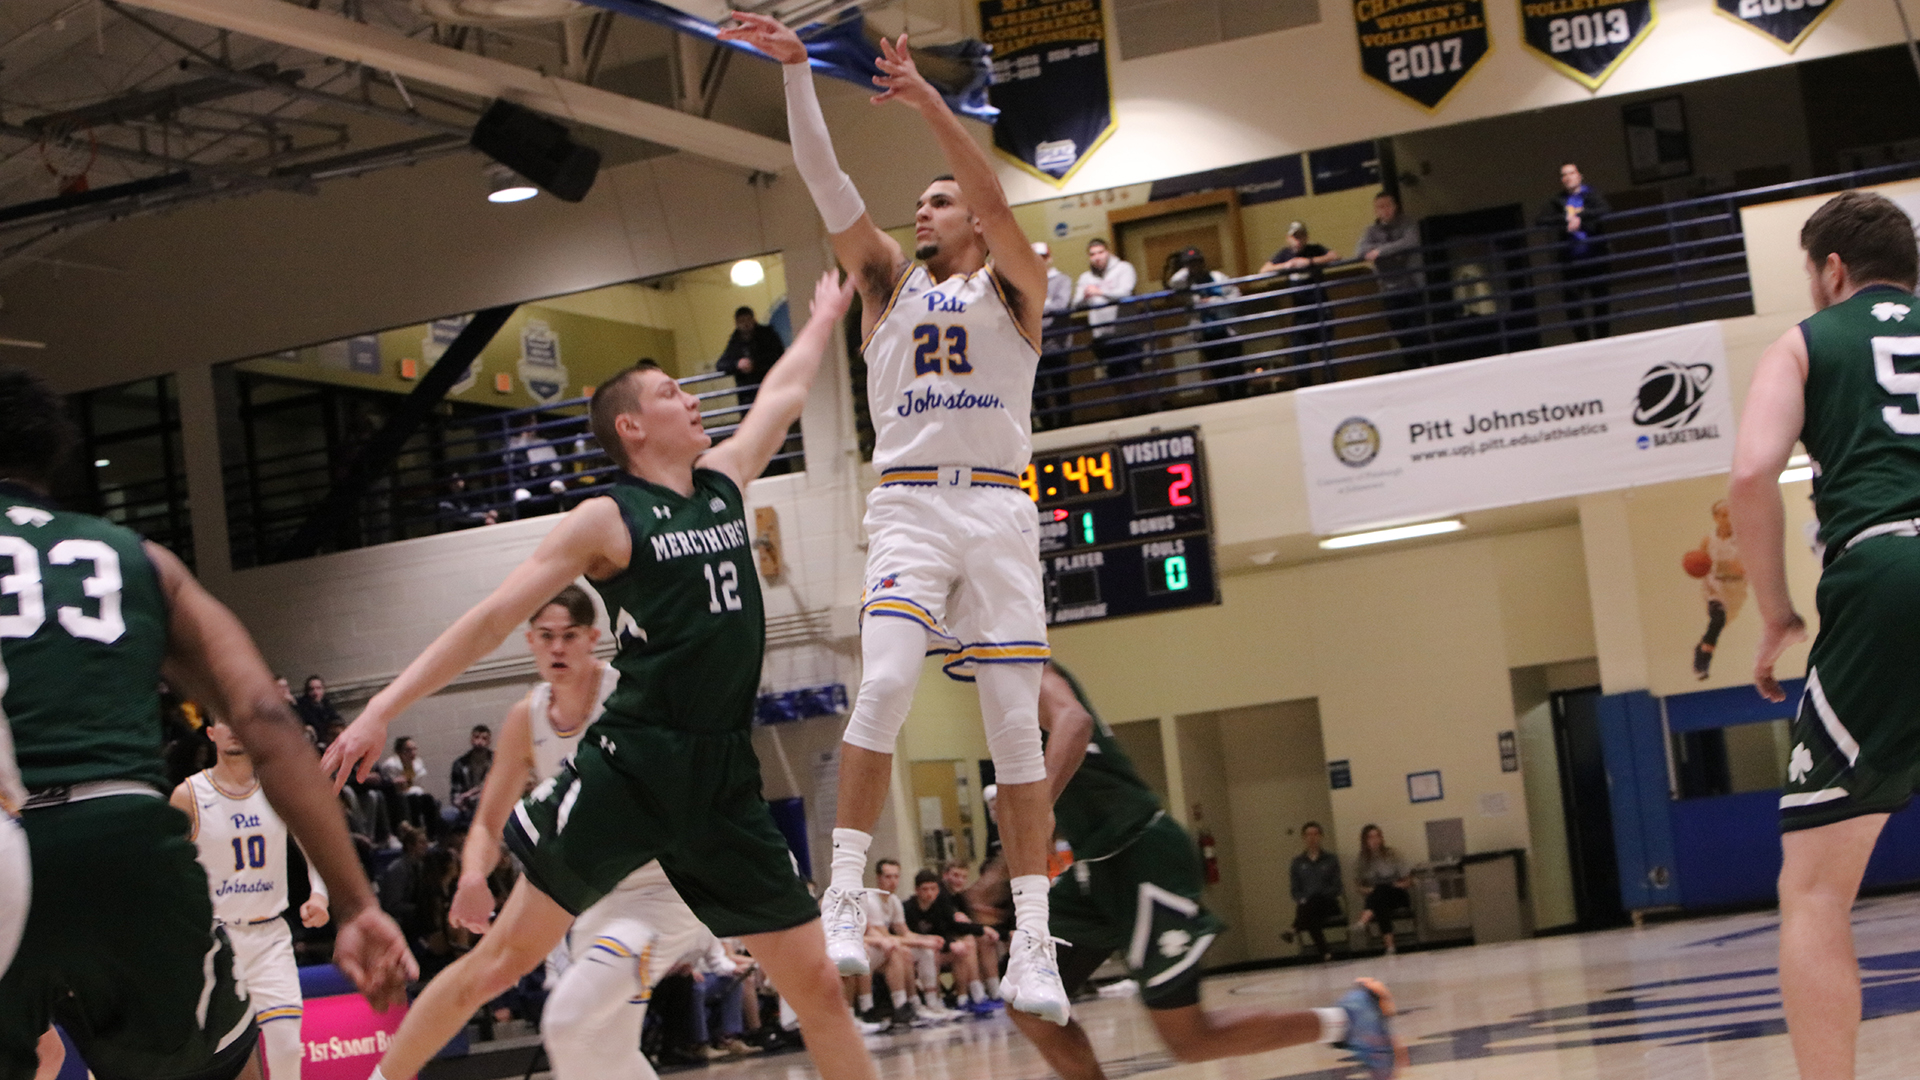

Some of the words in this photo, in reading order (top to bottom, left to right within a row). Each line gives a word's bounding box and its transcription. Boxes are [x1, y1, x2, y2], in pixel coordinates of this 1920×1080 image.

[1362, 15, 1484, 47] VOLLEYBALL
[1376, 3, 1466, 29] WOMEN'S
[1548, 8, 1630, 53] 2013
[1387, 36, 1462, 82] 2017
[923, 291, 967, 313] Pitt
[912, 322, 975, 378] 23
[1871, 336, 1920, 434] 5
[1409, 418, 1453, 443] Pitt
[1463, 398, 1604, 435] Johnstown
[1653, 424, 1720, 448] BASKETBALL
[1123, 436, 1194, 464] VISITOR
[1410, 423, 1608, 462] www.upj.pitt.edu/athletics
[950, 470, 960, 486] J
[1167, 463, 1193, 506] 2
[650, 518, 746, 562] MERCYHURS
[1082, 511, 1094, 544] 1
[1129, 515, 1176, 535] BONUS
[1055, 552, 1104, 571] PLAYER
[1142, 539, 1185, 558] FOULS
[0, 536, 126, 644] 33
[703, 560, 743, 614] 12
[1165, 556, 1188, 591] 0
[230, 813, 261, 829] Pitt
[231, 833, 266, 873] 10
